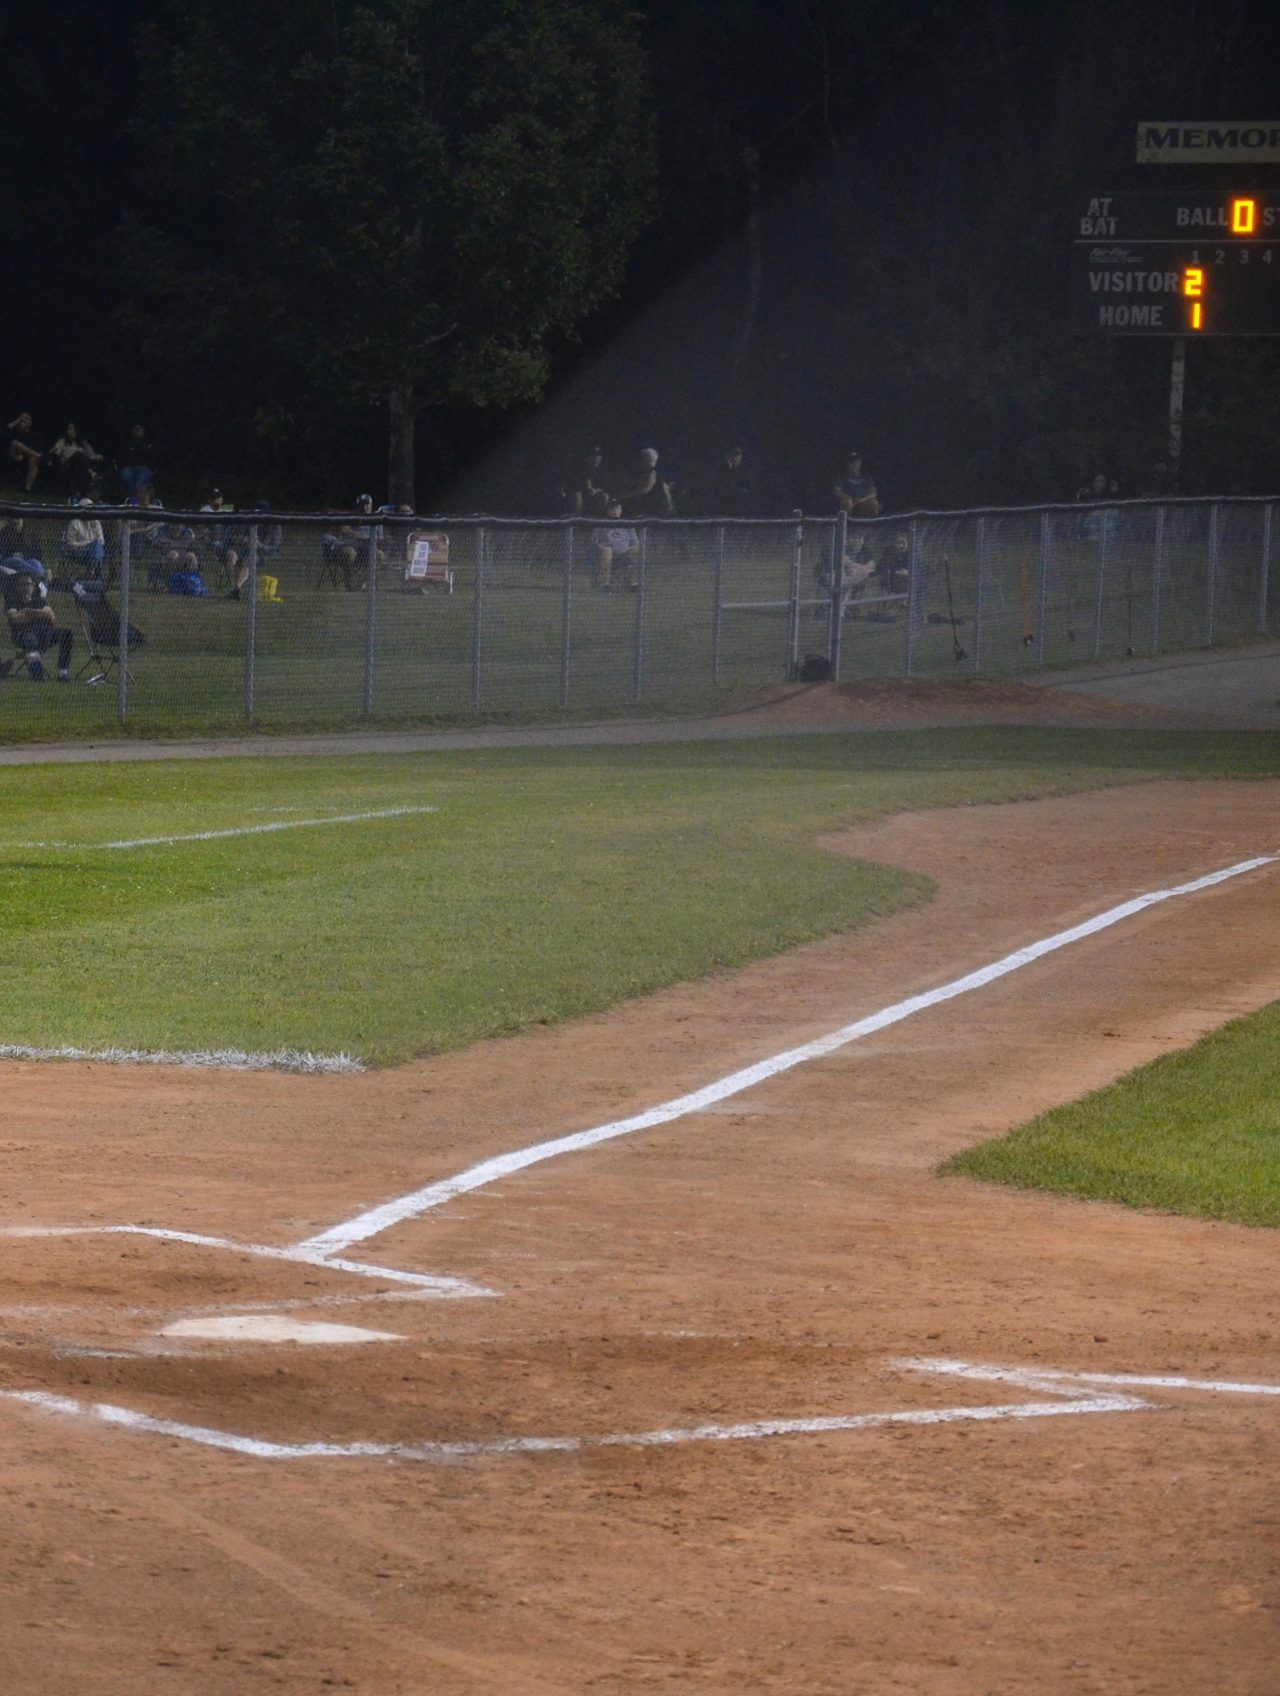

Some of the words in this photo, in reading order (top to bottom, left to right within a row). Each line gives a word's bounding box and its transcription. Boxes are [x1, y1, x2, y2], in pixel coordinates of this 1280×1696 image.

[1087, 198, 1113, 216] AT
[1176, 207, 1229, 226] BALL
[1233, 200, 1255, 232] 0
[1263, 207, 1280, 226] S
[1080, 217, 1119, 235] BAT
[1191, 250, 1200, 264] 1
[1215, 250, 1225, 264] 2
[1240, 250, 1250, 264] 3
[1262, 249, 1272, 264] 4
[1089, 272, 1179, 292] VISITOR
[1185, 269, 1203, 295] 2
[1099, 306, 1163, 326] HOME
[1192, 303, 1201, 328] 1
